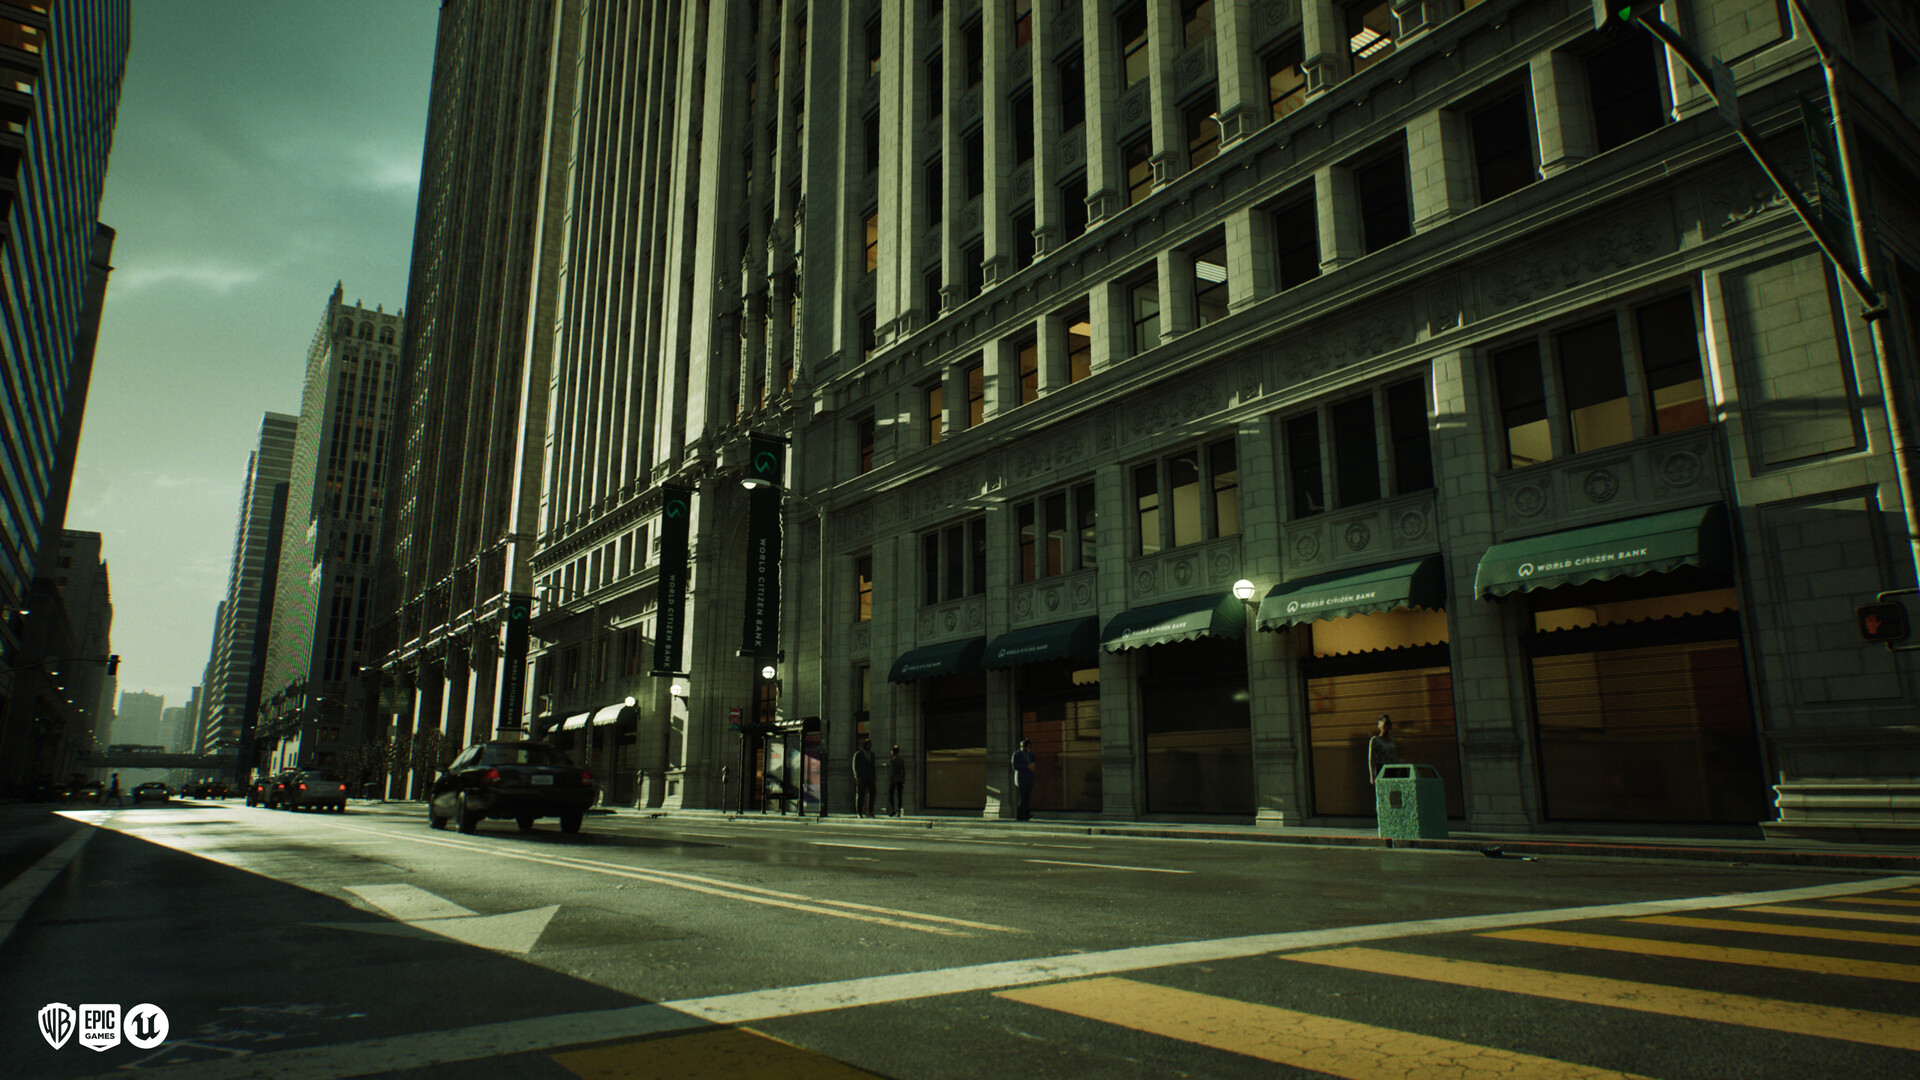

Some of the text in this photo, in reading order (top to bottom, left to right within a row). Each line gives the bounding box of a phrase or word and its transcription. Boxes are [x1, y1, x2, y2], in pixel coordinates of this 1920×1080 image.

[1537, 547, 1648, 572] WORLD CITIZEN BANK
[663, 574, 676, 668] WORLD CITIZEN BANK
[753, 538, 767, 647] WORLD CITIZEN BANK
[1300, 591, 1377, 609] WORLD CITIZEN BANK
